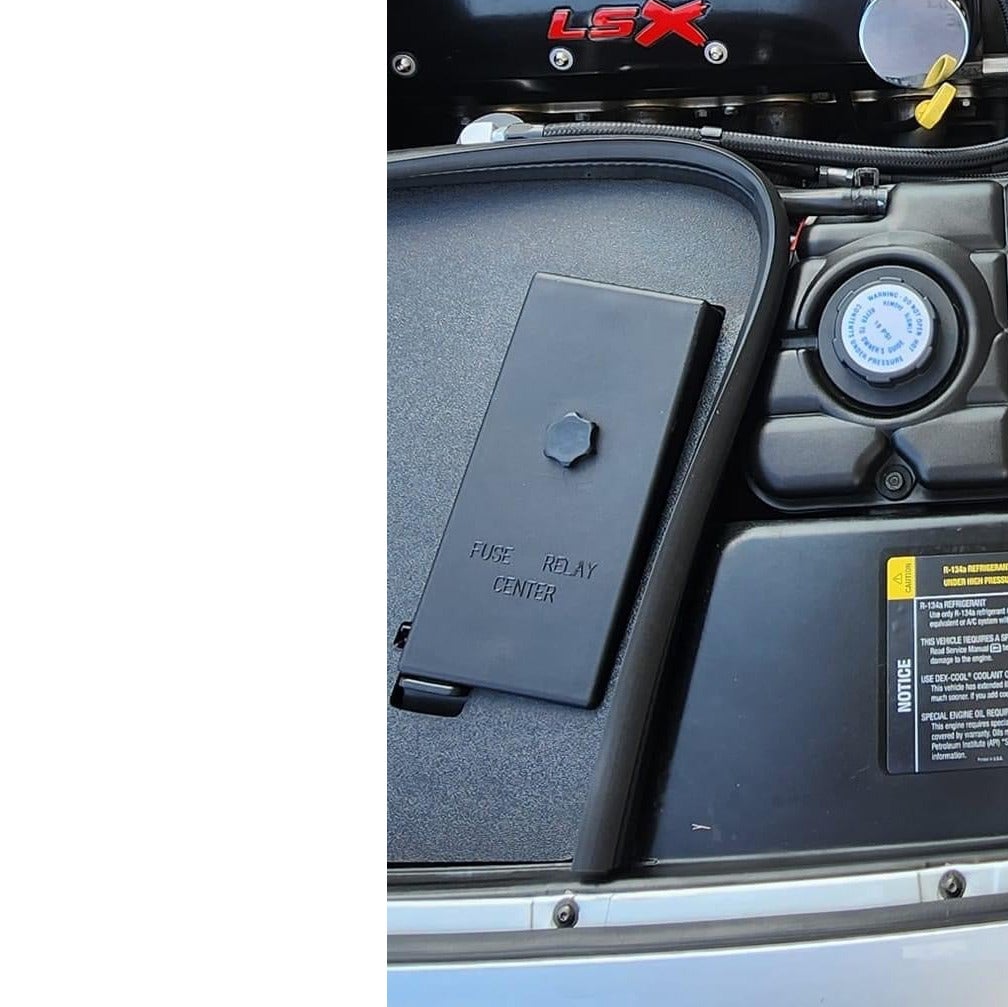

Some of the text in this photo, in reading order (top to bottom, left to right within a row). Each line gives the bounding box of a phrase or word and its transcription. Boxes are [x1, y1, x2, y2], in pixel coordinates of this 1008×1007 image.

[867, 291, 899, 302] WARNING
[867, 355, 904, 366] PRESSURE
[468, 540, 598, 580] FUSE RELAY
[943, 565, 966, 573] R-134a
[943, 577, 966, 586] UNDER
[967, 576, 983, 585] HIGH
[492, 575, 558, 604] CENTER
[919, 598, 986, 609] R-134a REFRIGERANT
[920, 637, 935, 646] THIS
[936, 636, 961, 645] VEHICLE
[962, 634, 993, 644] REQUIRES
[920, 674, 934, 683] USE
[972, 670, 1003, 680] COOLANT
[898, 658, 912, 712] NOTICE
[921, 711, 947, 721] SPECIAL
[949, 710, 973, 719] ENGINE
[974, 709, 985, 718] OIL
[931, 751, 966, 760] information.
